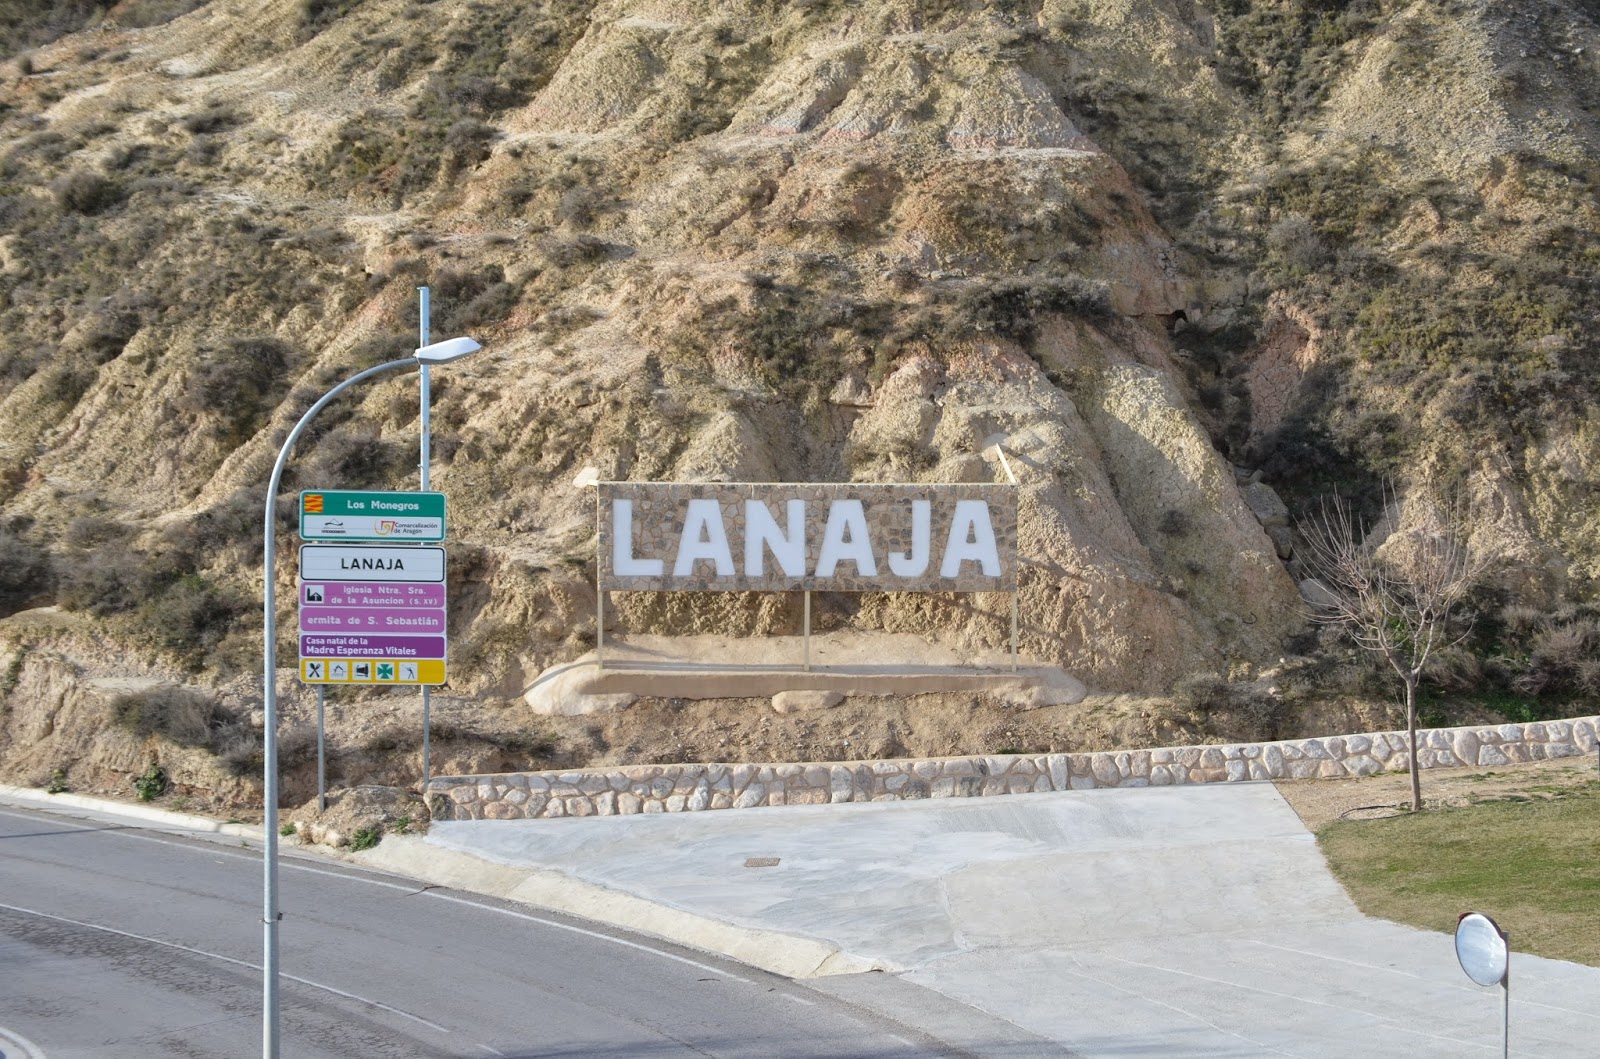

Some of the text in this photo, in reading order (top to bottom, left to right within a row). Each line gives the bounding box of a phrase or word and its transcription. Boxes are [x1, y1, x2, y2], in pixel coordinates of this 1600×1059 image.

[347, 500, 420, 511] Los Monegros
[612, 500, 1000, 577] LANAJA
[341, 558, 404, 570] LANAJA
[378, 586, 402, 594] Ntra.
[362, 597, 404, 605] Asuncion
[307, 616, 438, 626] ermita de S. Sebastián
[306, 637, 325, 645] Casa
[326, 637, 347, 645] natal
[306, 646, 416, 656] Madre Esperanza Vitales
